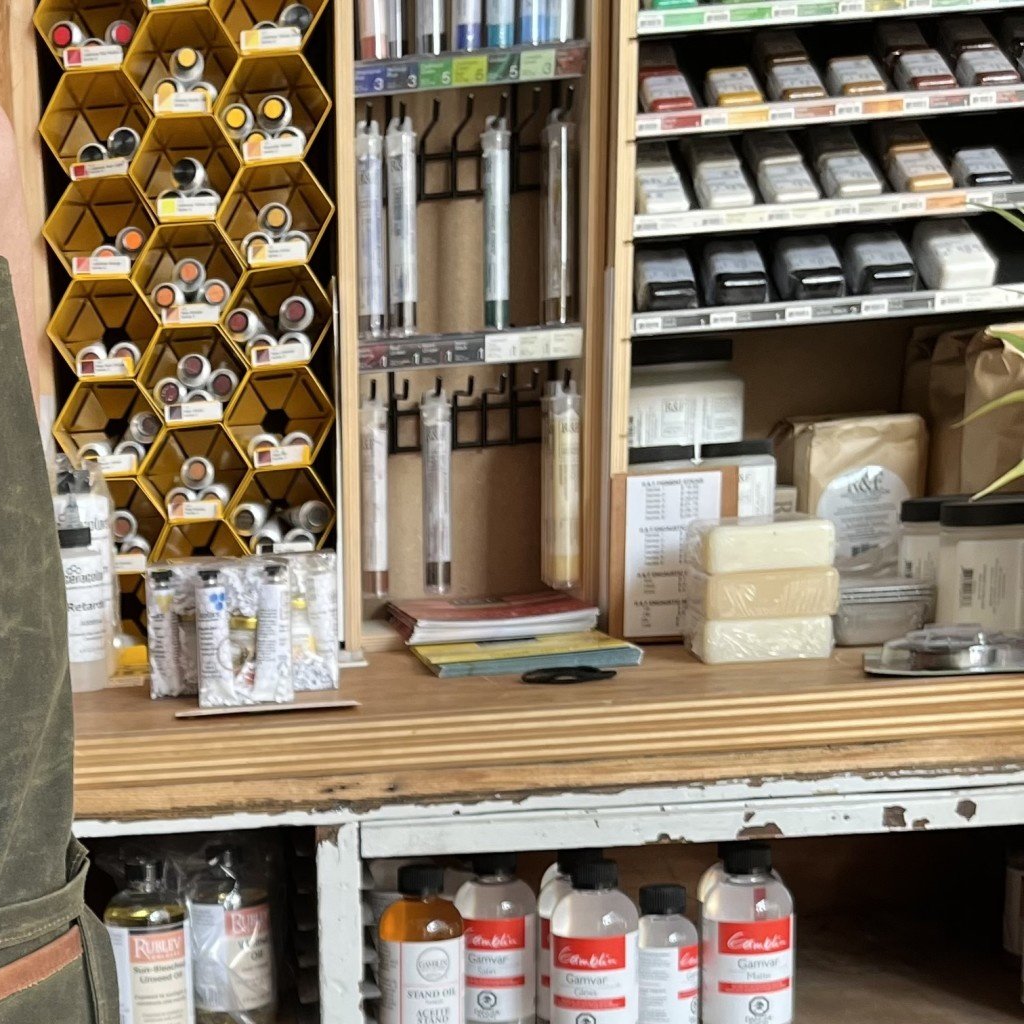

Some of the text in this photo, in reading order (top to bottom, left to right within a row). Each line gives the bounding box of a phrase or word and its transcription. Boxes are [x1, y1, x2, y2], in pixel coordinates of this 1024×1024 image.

[374, 78, 384, 91] 3
[407, 74, 418, 88] 3
[134, 935, 182, 959] RUBLEV
[726, 930, 788, 951] Gamblin
[468, 953, 506, 965] Gamvar
[557, 945, 617, 968] Gamblin
[738, 958, 779, 970] Gamvar
[565, 973, 606, 985] Gamvar
[407, 987, 456, 1000] STAND OIL
[416, 1016, 450, 1024] STAND
